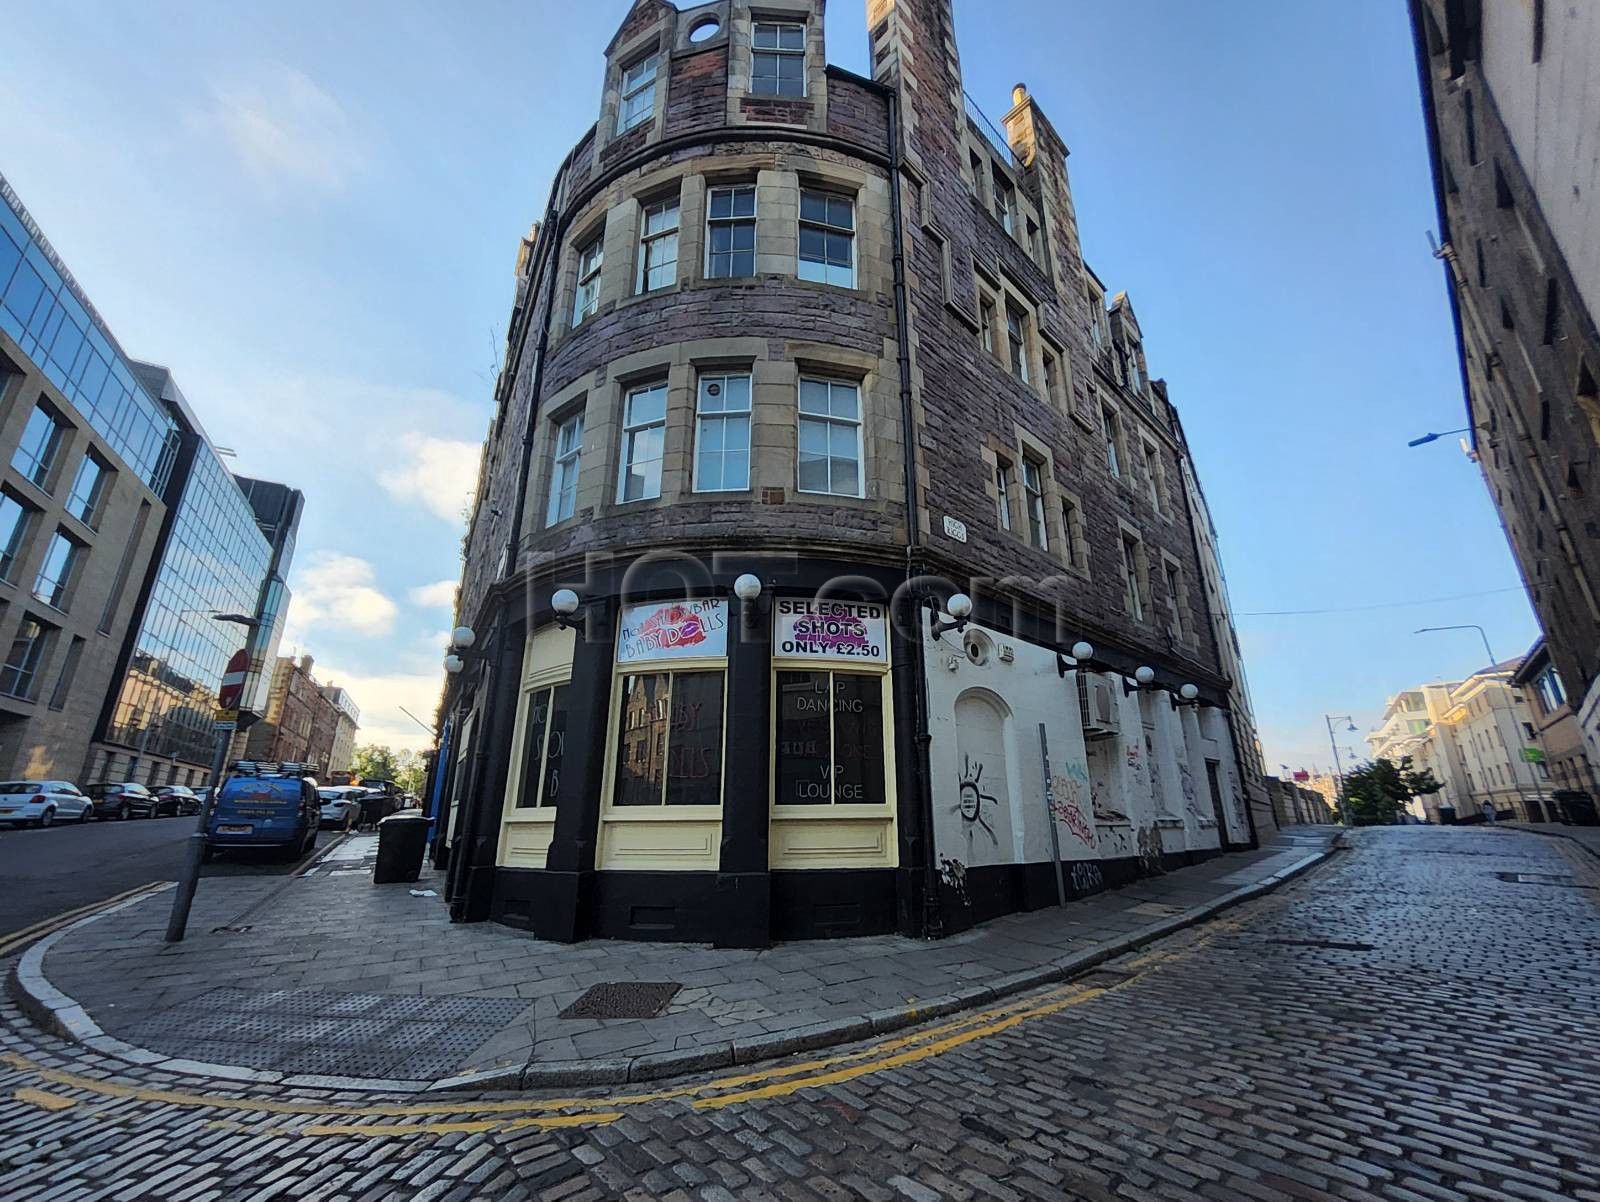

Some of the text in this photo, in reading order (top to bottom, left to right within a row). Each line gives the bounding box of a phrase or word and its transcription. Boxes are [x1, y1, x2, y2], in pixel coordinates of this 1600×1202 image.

[779, 601, 880, 619] SELECTED
[799, 620, 865, 637] SHOTS
[626, 629, 661, 657] BABY
[782, 641, 880, 656] ONLY £2.50
[819, 765, 844, 779] VP
[799, 783, 864, 798] LOUNGE
